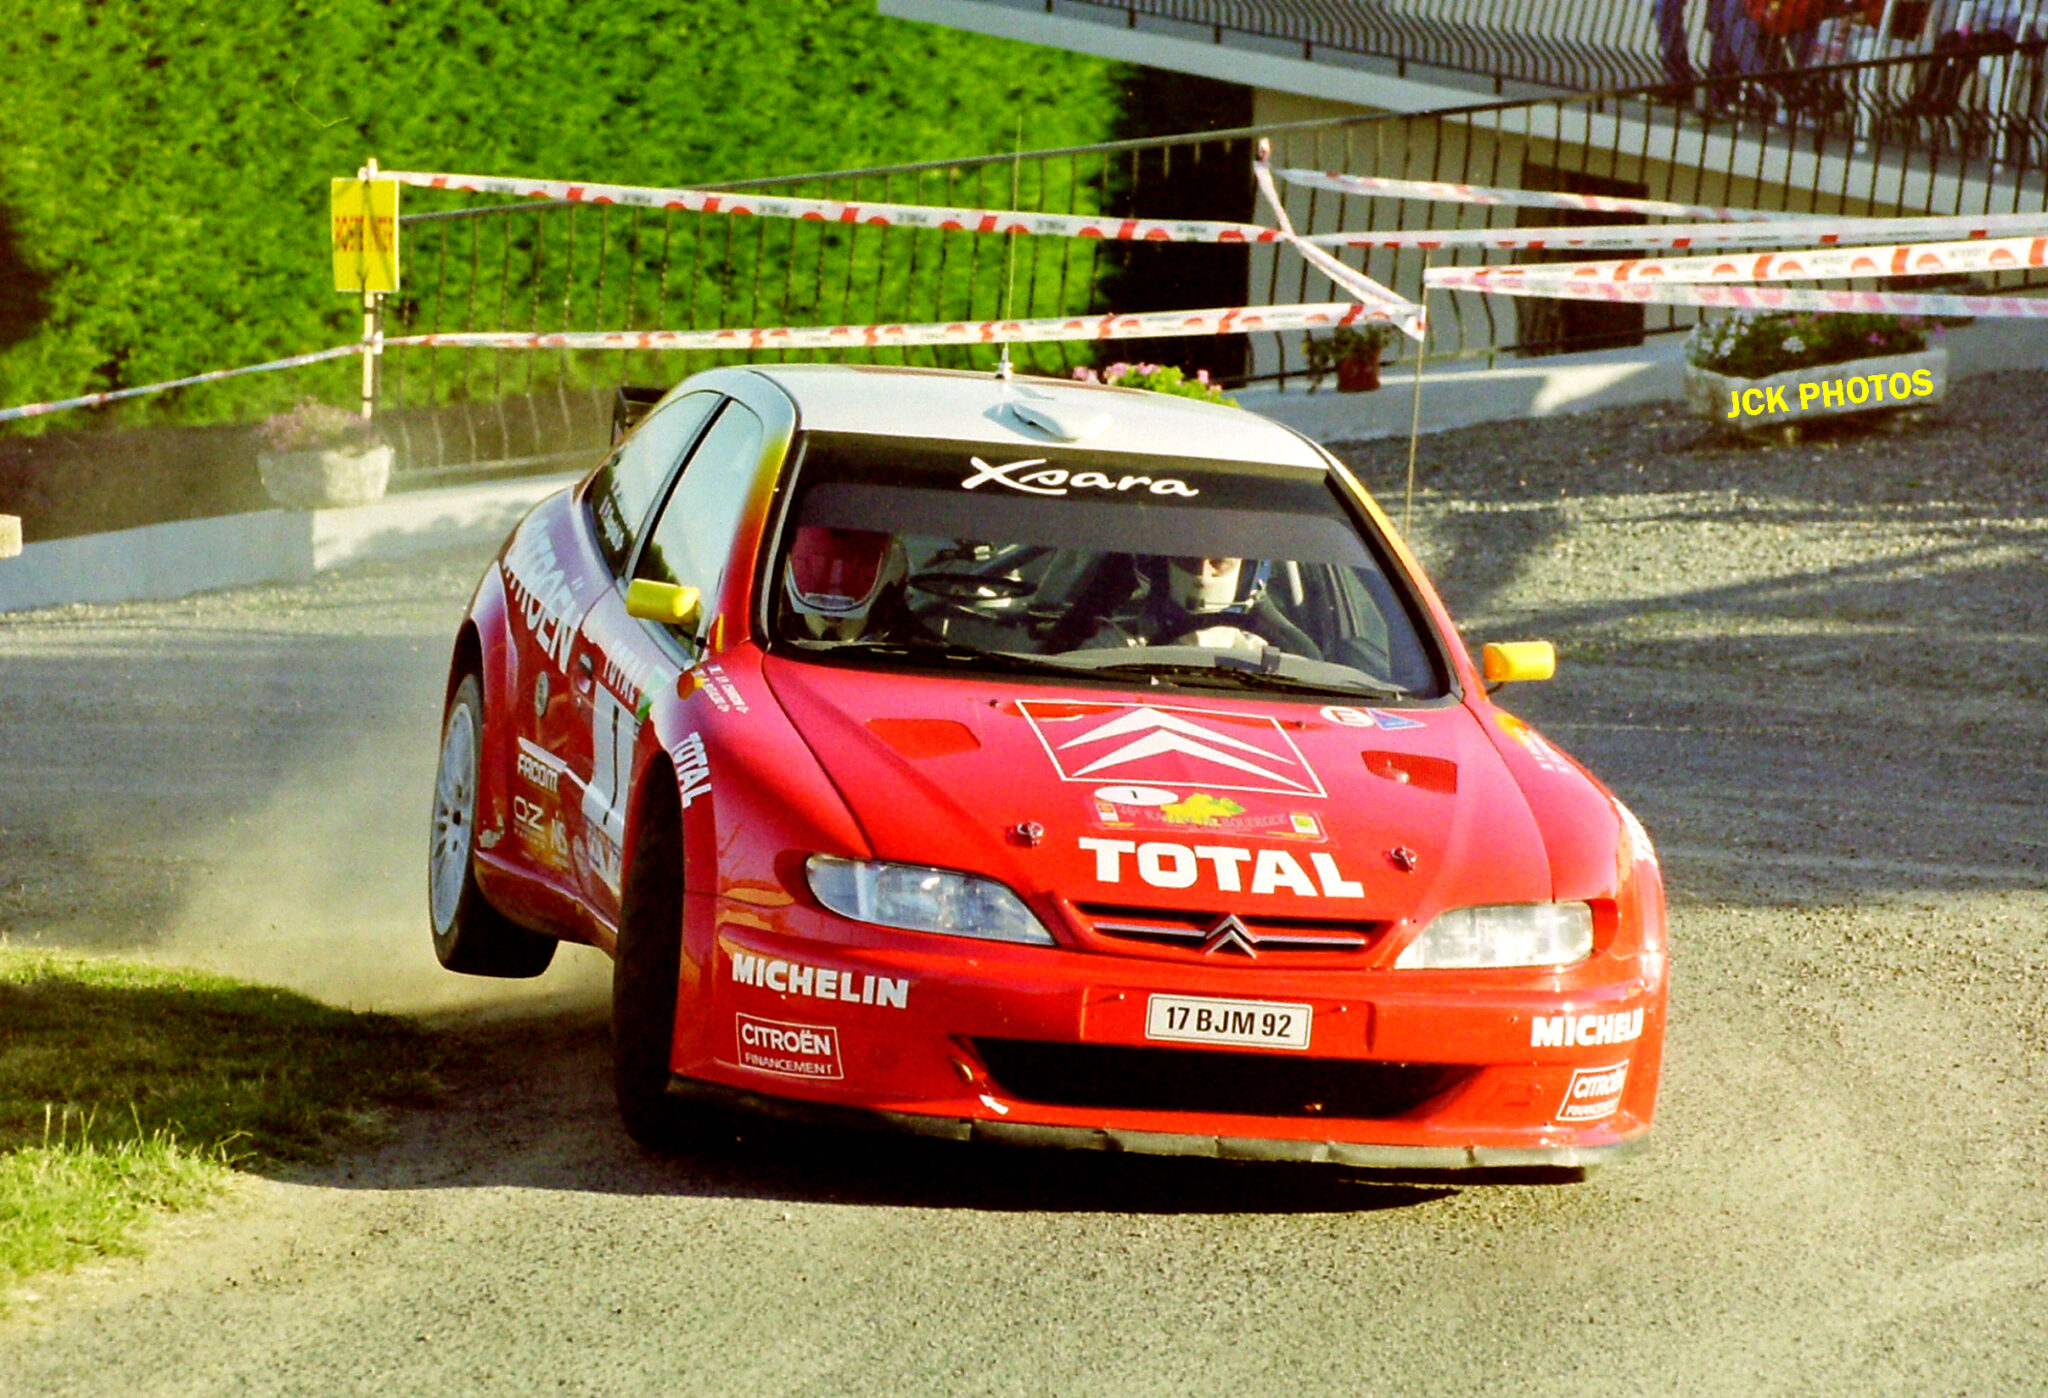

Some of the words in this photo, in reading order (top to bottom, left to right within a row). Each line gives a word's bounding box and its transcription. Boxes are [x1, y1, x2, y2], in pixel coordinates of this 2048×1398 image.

[962, 457, 1199, 496] Xsara
[672, 732, 712, 809] TOTAL
[1078, 837, 1365, 898] TOTAL
[732, 953, 909, 1009] MICHELIN
[742, 1022, 831, 1056] CITROËN
[1166, 1006, 1190, 1030] 17
[1196, 1008, 1255, 1035] BJM
[1262, 1013, 1292, 1038] 92
[745, 1052, 833, 1075] FINANCEMENT
